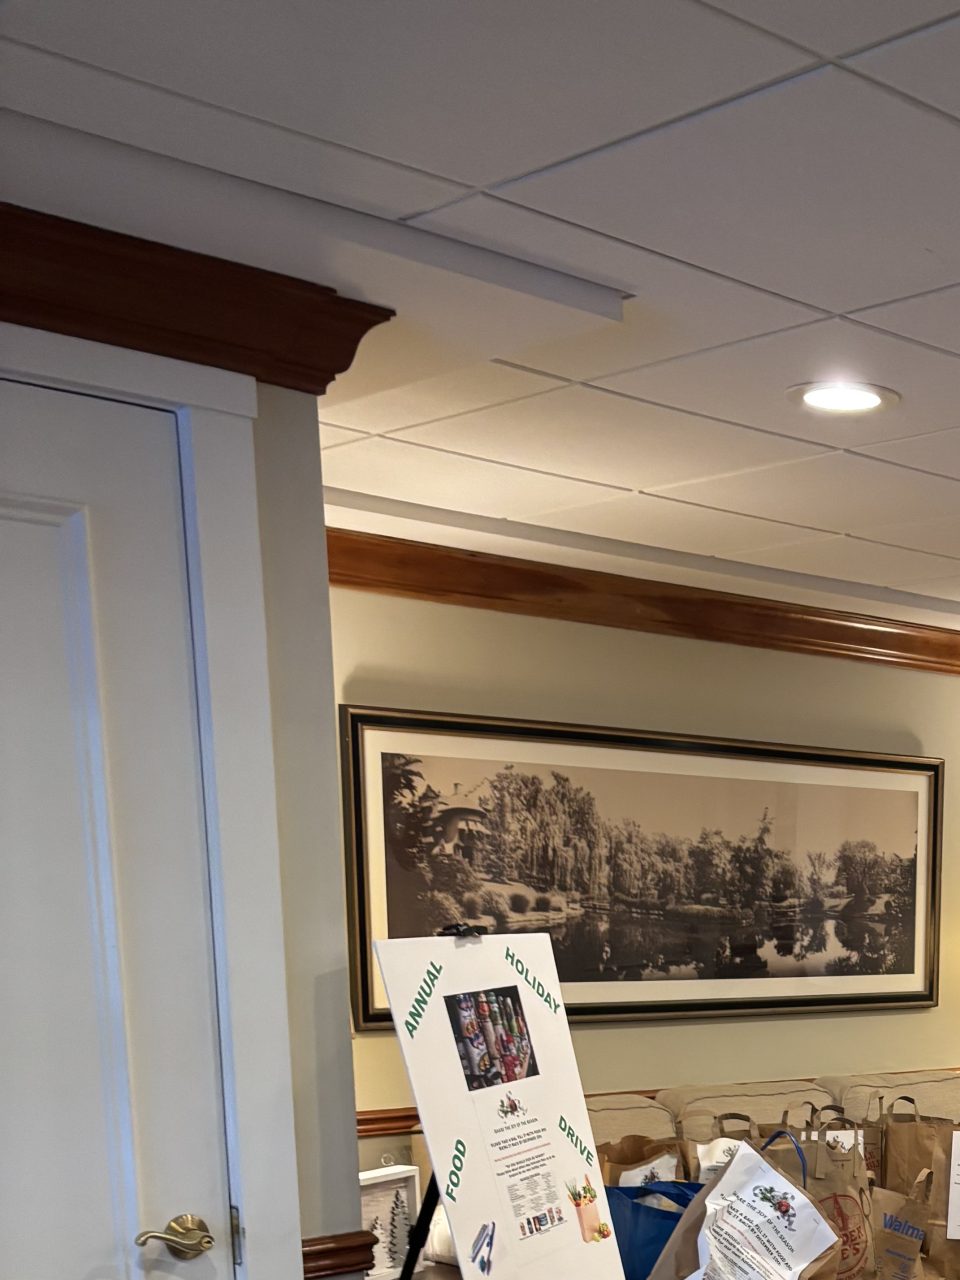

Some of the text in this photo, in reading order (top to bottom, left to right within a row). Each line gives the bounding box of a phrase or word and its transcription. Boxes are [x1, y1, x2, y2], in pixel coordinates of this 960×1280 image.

[404, 961, 443, 1039] ANNUAL
[504, 947, 560, 1014] HOLIDAY
[445, 1139, 467, 1203] FOOD
[558, 1115, 594, 1167] DRIVE
[883, 1213, 926, 1241] Walma
